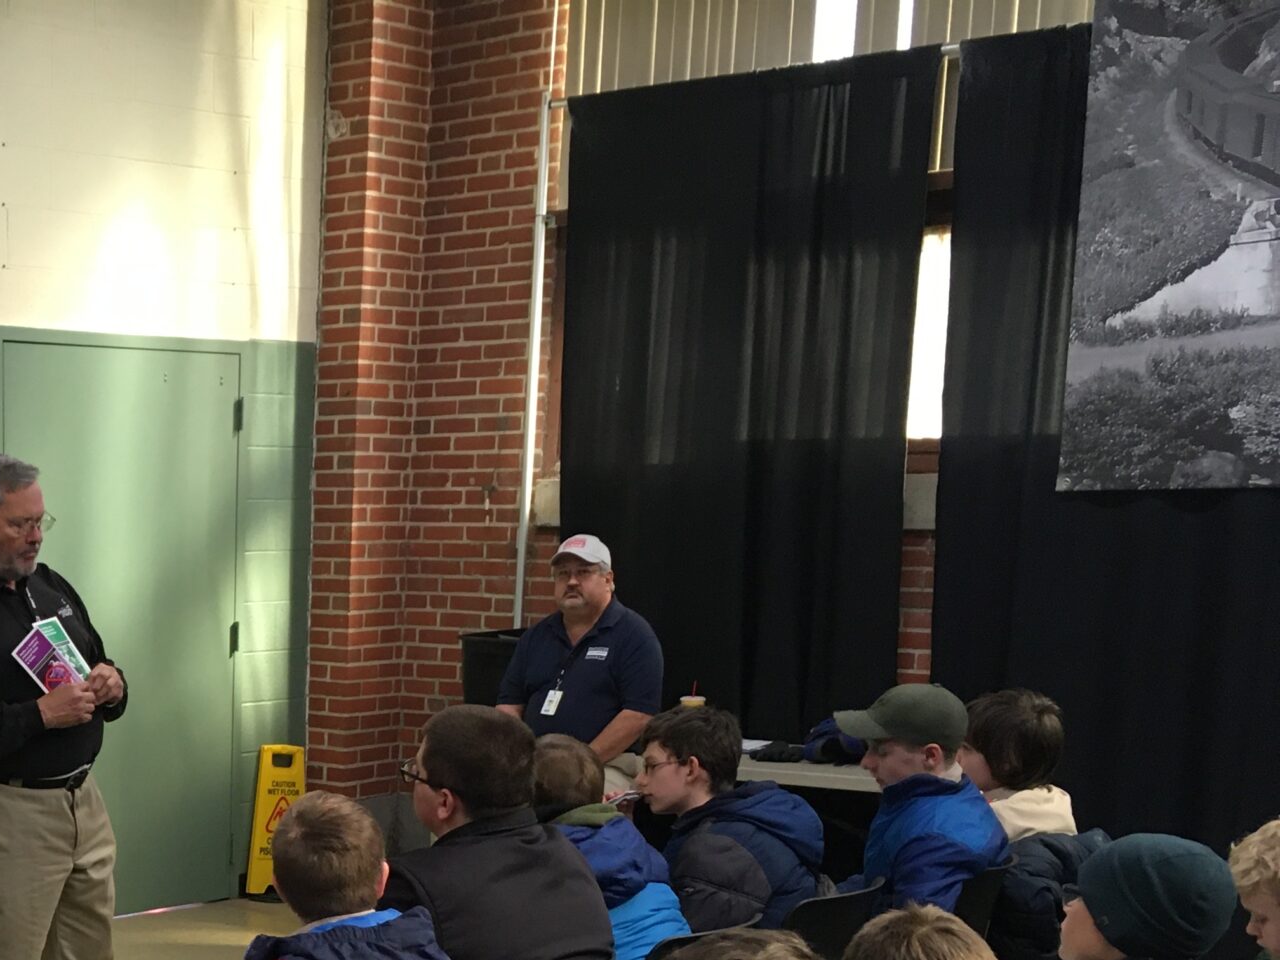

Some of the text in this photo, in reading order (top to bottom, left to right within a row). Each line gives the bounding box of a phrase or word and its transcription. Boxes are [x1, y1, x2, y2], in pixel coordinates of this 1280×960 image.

[272, 780, 296, 788] CAUTION
[268, 788, 300, 796] WET FLOOR
